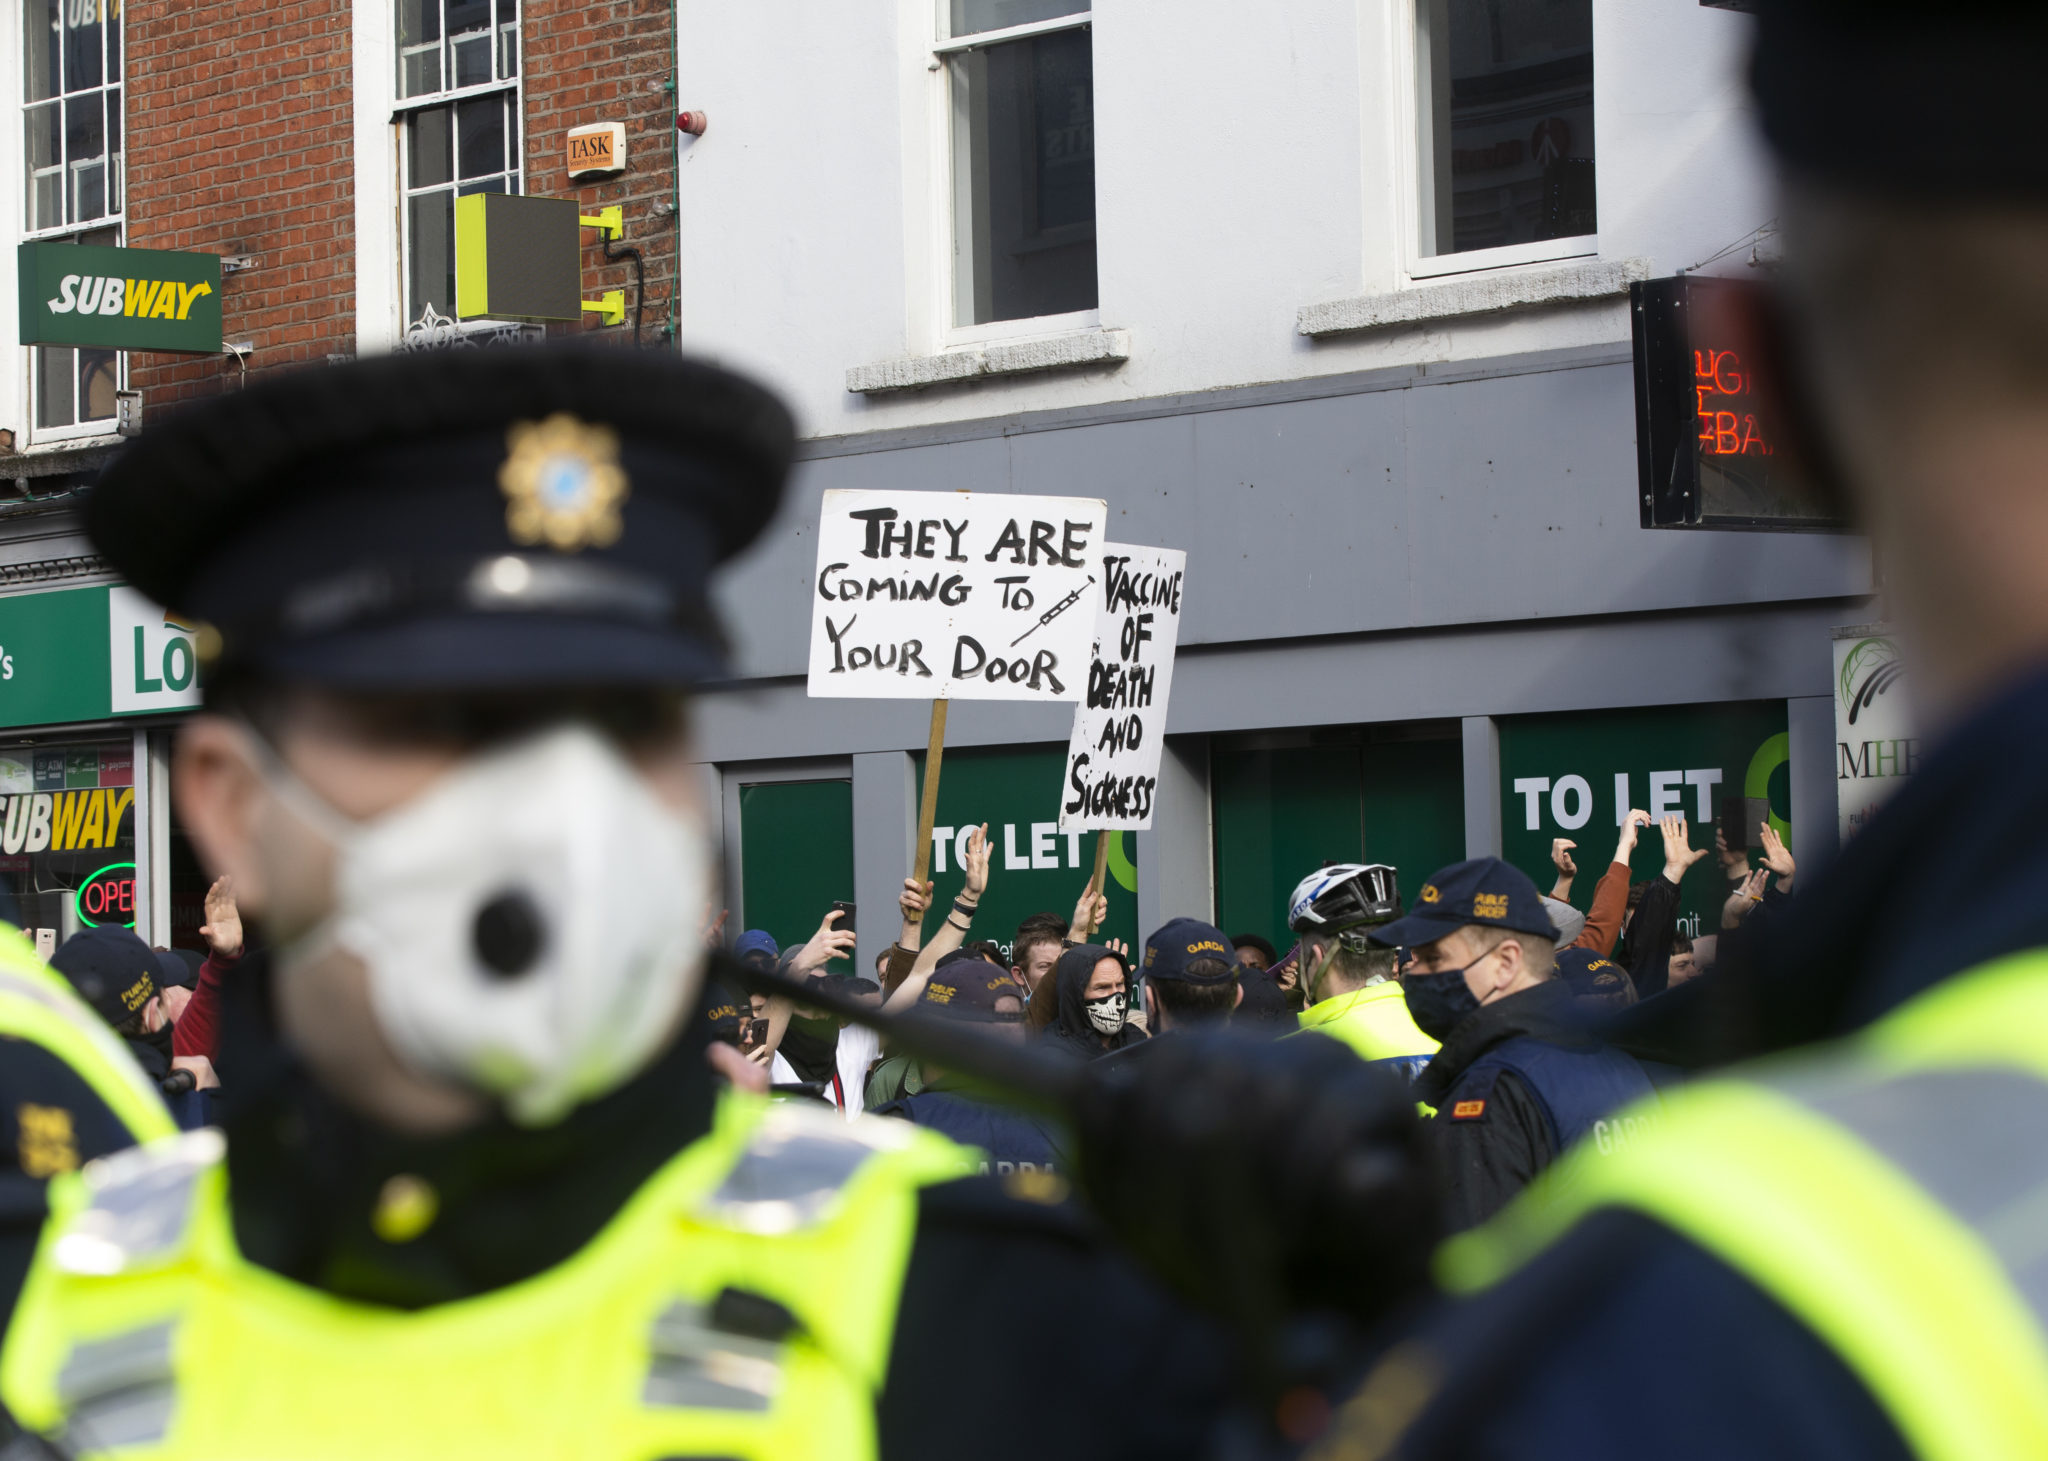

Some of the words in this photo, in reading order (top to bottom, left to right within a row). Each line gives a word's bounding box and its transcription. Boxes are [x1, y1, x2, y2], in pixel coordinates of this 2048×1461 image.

[569, 135, 610, 159] TASK
[47, 274, 213, 321] SUBWAY
[849, 507, 969, 563] THEY
[984, 518, 1093, 569] ARE
[818, 562, 973, 607] COMING
[993, 575, 1035, 611] TO
[1102, 556, 1183, 615] VACCINE
[825, 612, 934, 678] YOUR
[951, 634, 1066, 696] DOOR
[1120, 612, 1154, 664] OF
[1087, 658, 1155, 710] DEATH
[1098, 713, 1143, 759] AND
[1065, 752, 1156, 821] SICKNESS
[1514, 774, 1593, 831] TO
[1614, 768, 1722, 827] LET
[931, 824, 988, 873] TO
[1004, 821, 1089, 870] LET
[1187, 940, 1225, 954] GARDA
[1676, 911, 1701, 937] nit
